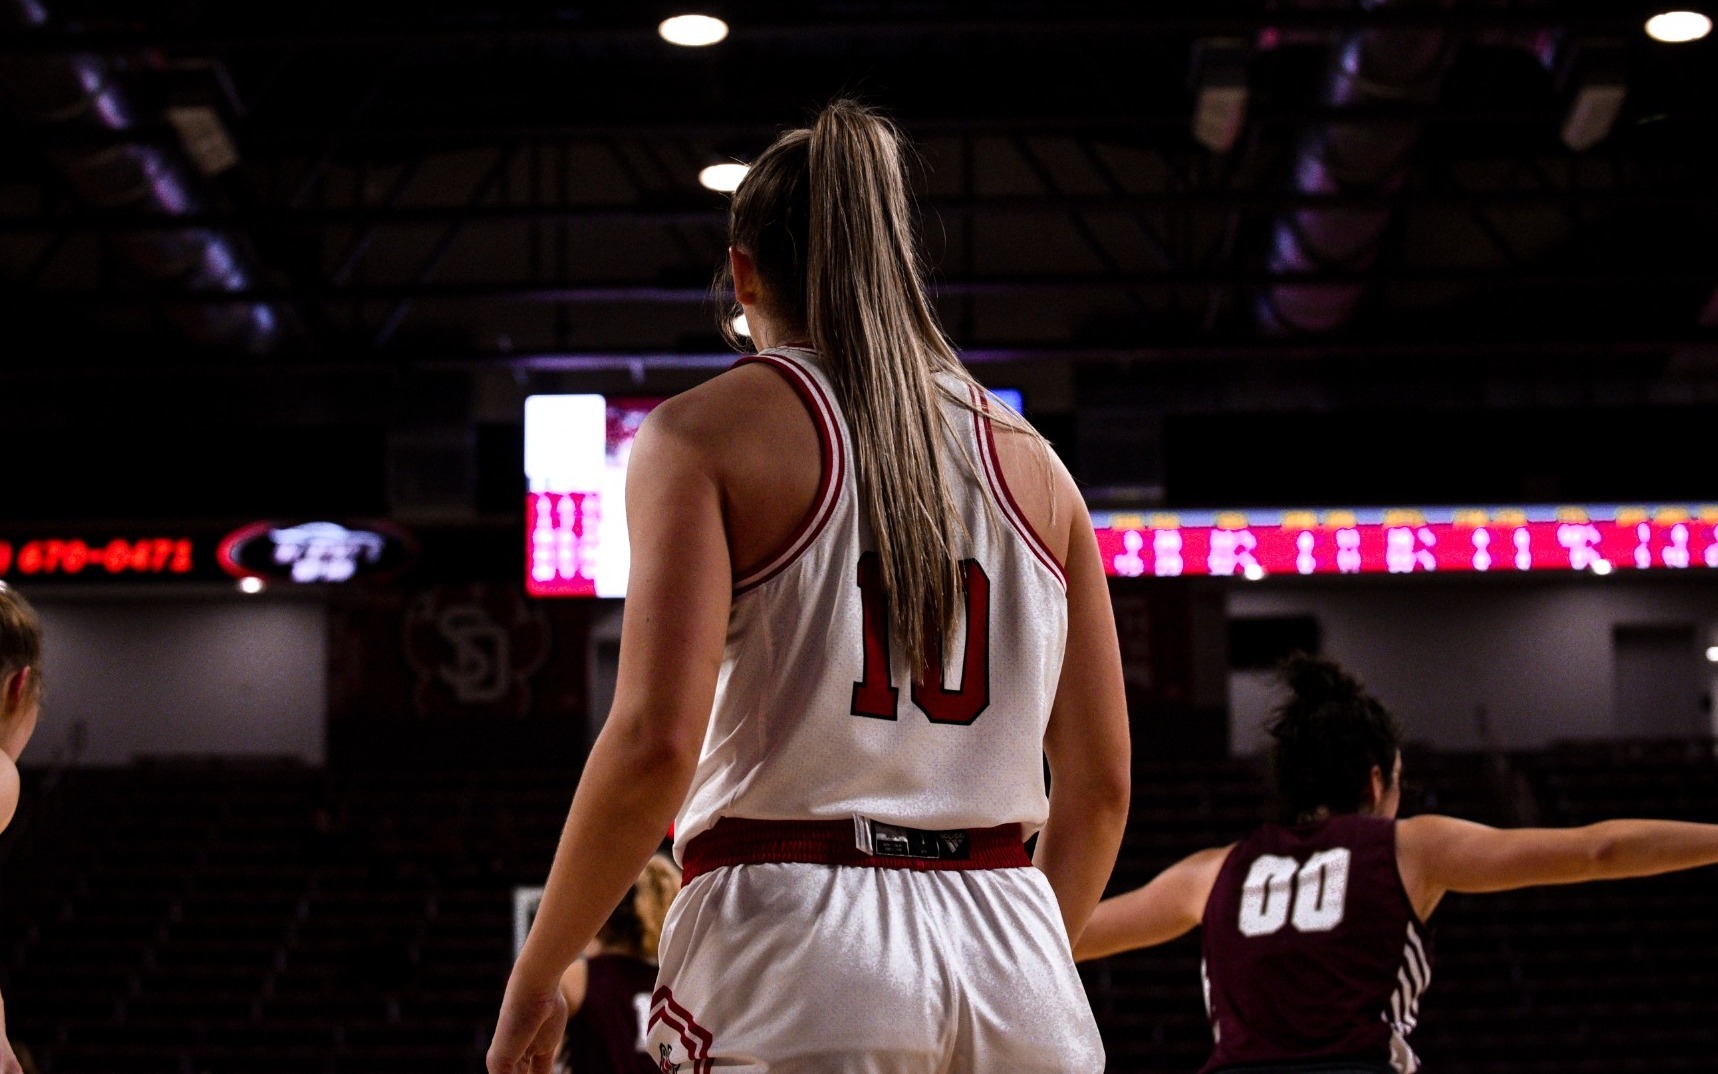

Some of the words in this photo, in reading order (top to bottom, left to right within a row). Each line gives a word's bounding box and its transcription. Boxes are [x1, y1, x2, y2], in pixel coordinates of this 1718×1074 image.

[18, 539, 192, 573] 670-0471
[850, 551, 990, 725] 10
[1238, 847, 1351, 937] 00
